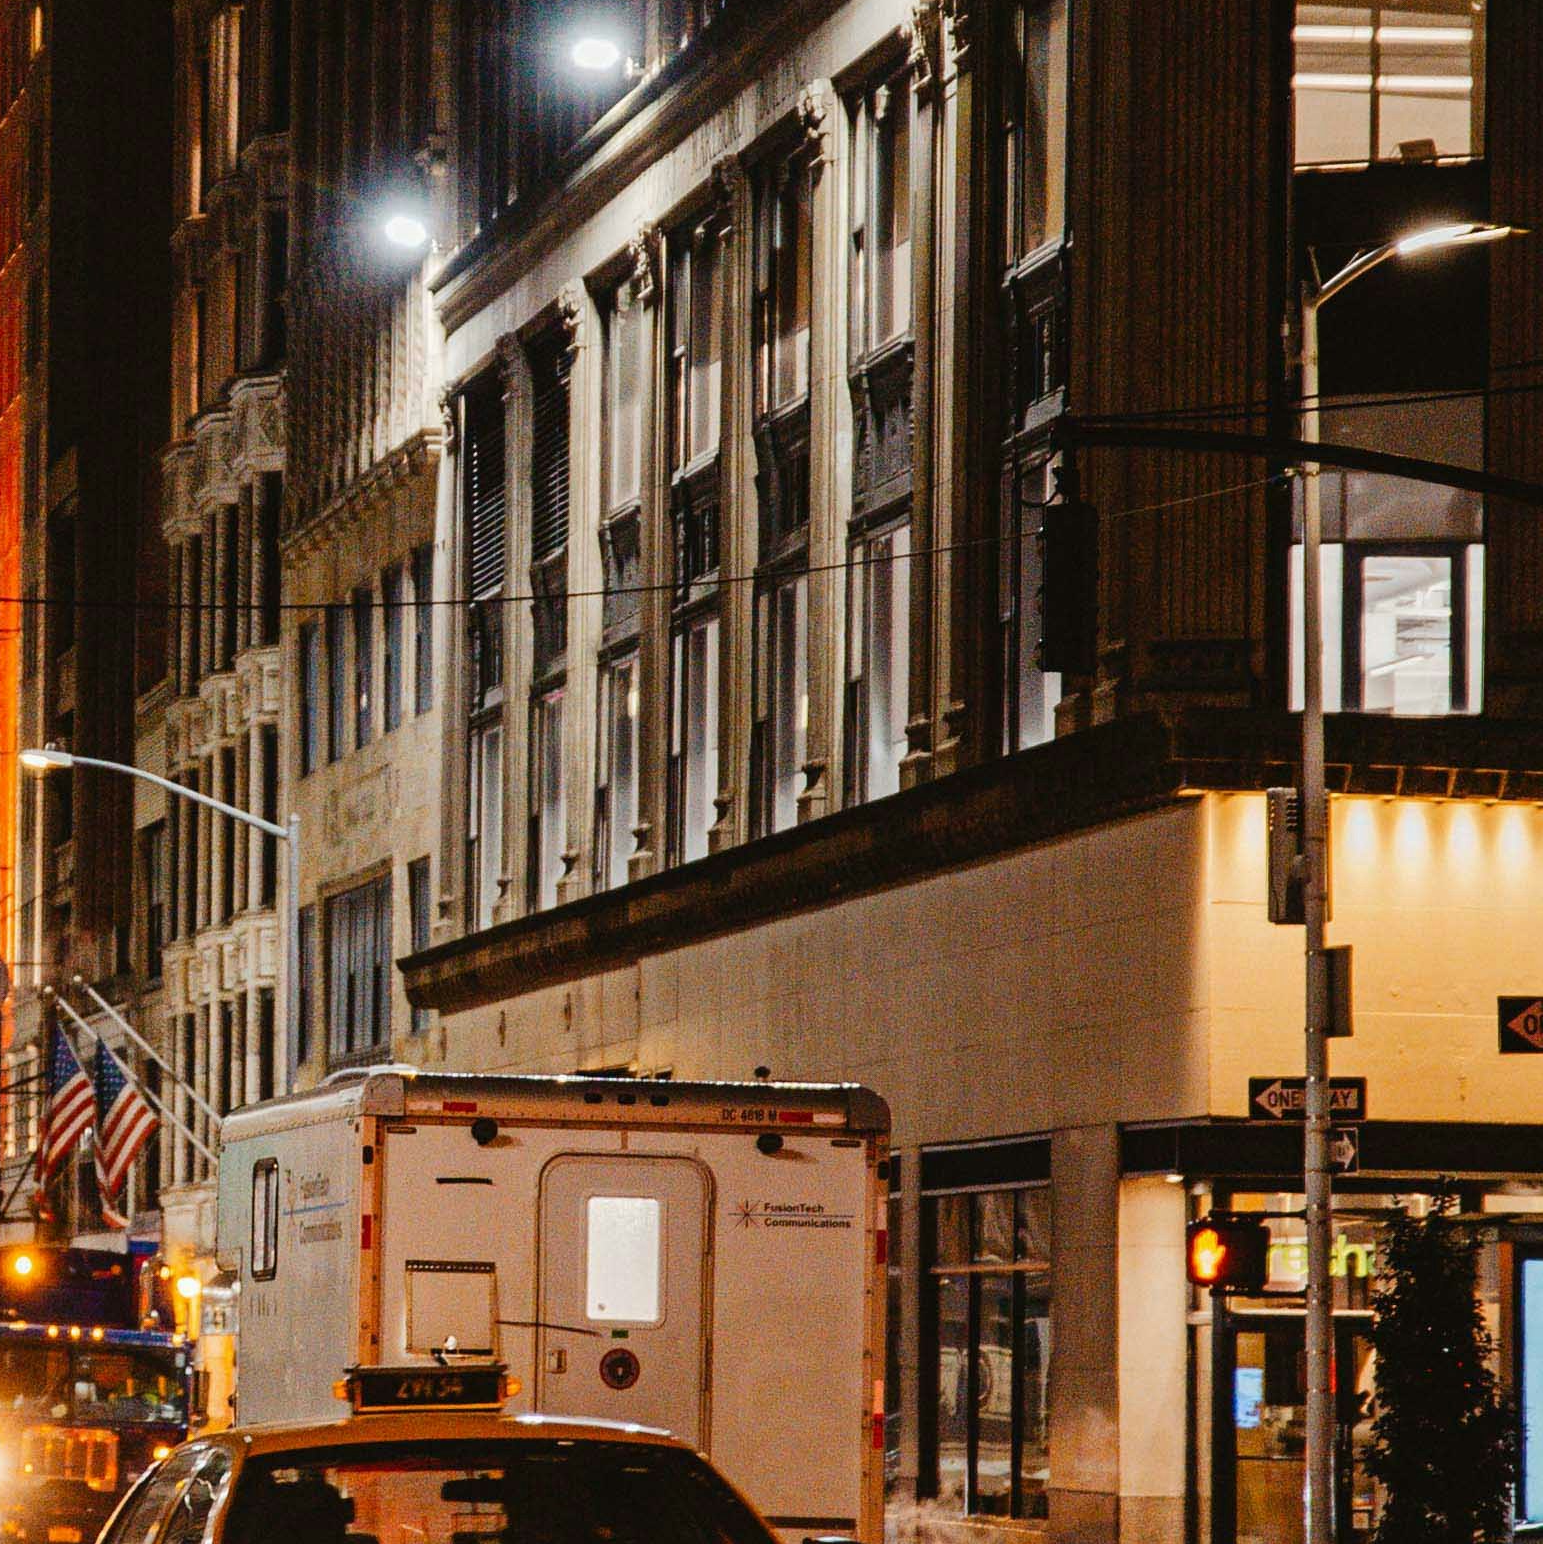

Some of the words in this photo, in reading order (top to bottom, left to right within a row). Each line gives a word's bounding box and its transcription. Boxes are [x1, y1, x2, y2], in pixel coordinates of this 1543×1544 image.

[1268, 1091, 1304, 1107] ONE
[1330, 1091, 1352, 1107] AY
[764, 1202, 825, 1213] FusionTech
[764, 1217, 852, 1229] Communications
